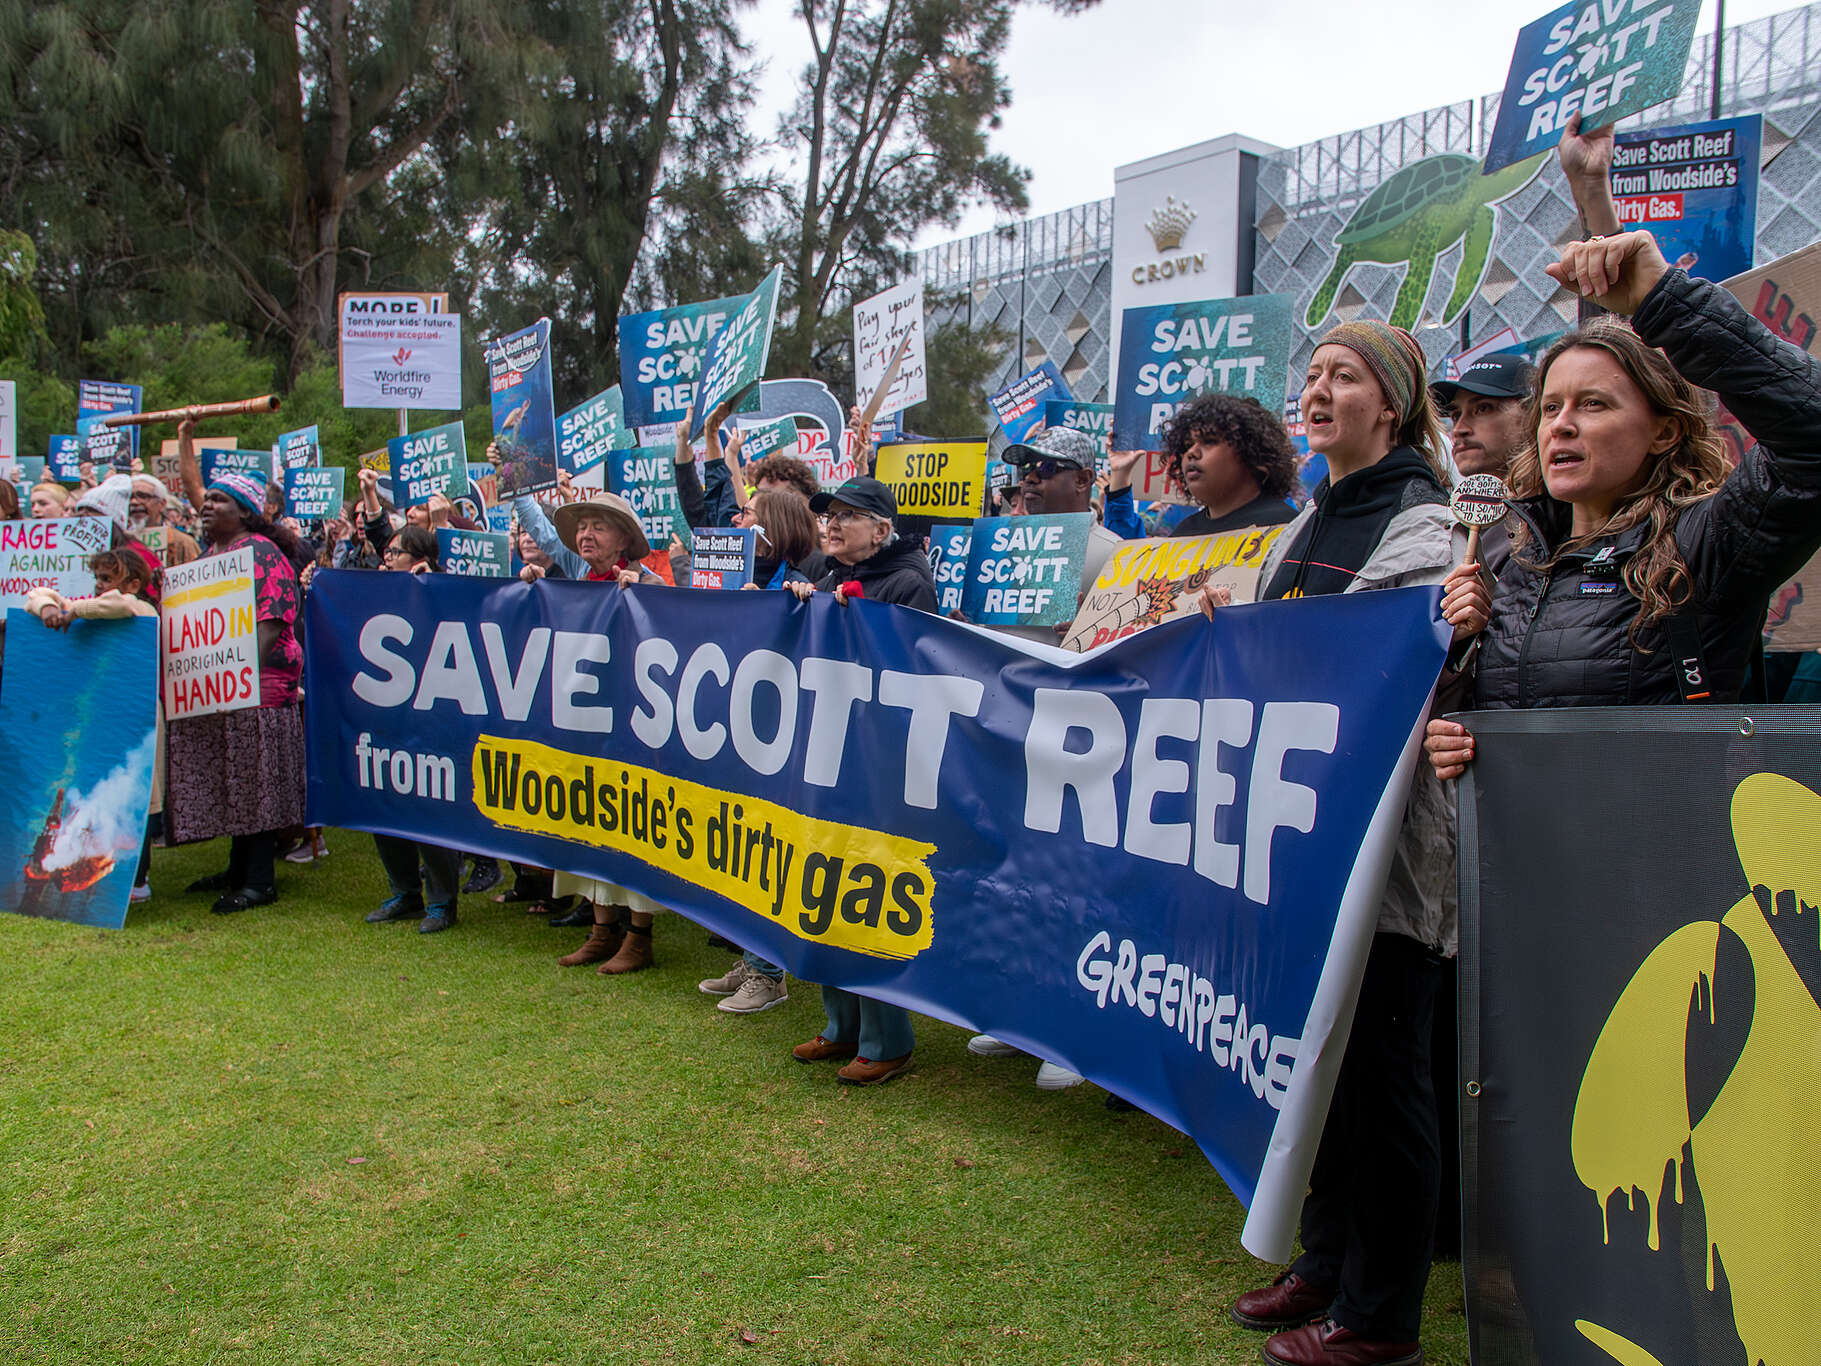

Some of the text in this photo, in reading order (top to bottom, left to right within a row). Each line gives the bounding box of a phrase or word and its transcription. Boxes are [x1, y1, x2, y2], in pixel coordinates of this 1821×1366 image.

[1525, 61, 1643, 142] REEF
[1613, 131, 1732, 167] Save Scott Reef
[1612, 162, 1737, 194] from Woodside's
[1649, 197, 1681, 218] Gas.
[1131, 253, 1208, 285] CROWN
[857, 294, 916, 338] Pay your
[1151, 314, 1254, 354] SAVE
[374, 370, 431, 383] Worldfire
[381, 383, 423, 398] Energy
[561, 399, 607, 436] SAVE
[403, 433, 448, 460] SAVE
[572, 437, 617, 470] REEF
[740, 428, 781, 460] REEF
[215, 453, 260, 469] SAVE
[623, 457, 670, 482] SAVE
[904, 452, 949, 479] STOP
[295, 472, 332, 487] SAVE
[408, 473, 451, 500] REEF
[294, 500, 330, 515] REEF
[1, 523, 59, 552] RAGE
[641, 515, 673, 540] EEF
[991, 526, 1064, 552] SAVE
[450, 538, 495, 559] SAVE
[695, 536, 744, 552] Save Scott Reef
[9, 553, 76, 573] AGAINST
[163, 554, 249, 593] ABORIGINAL
[694, 554, 709, 569] from
[693, 571, 708, 589] Dirty
[983, 588, 1054, 614] REEF
[1085, 591, 1123, 613] NOT
[168, 603, 253, 654] LAND IN
[167, 645, 247, 679] ABORIGINAL
[173, 665, 253, 715] HANDS
[351, 613, 1340, 906] SAVE SCOTT REEF
[355, 732, 925, 937] from Woodside's dirty gas
[1077, 930, 1301, 1111] GREENPEACE
